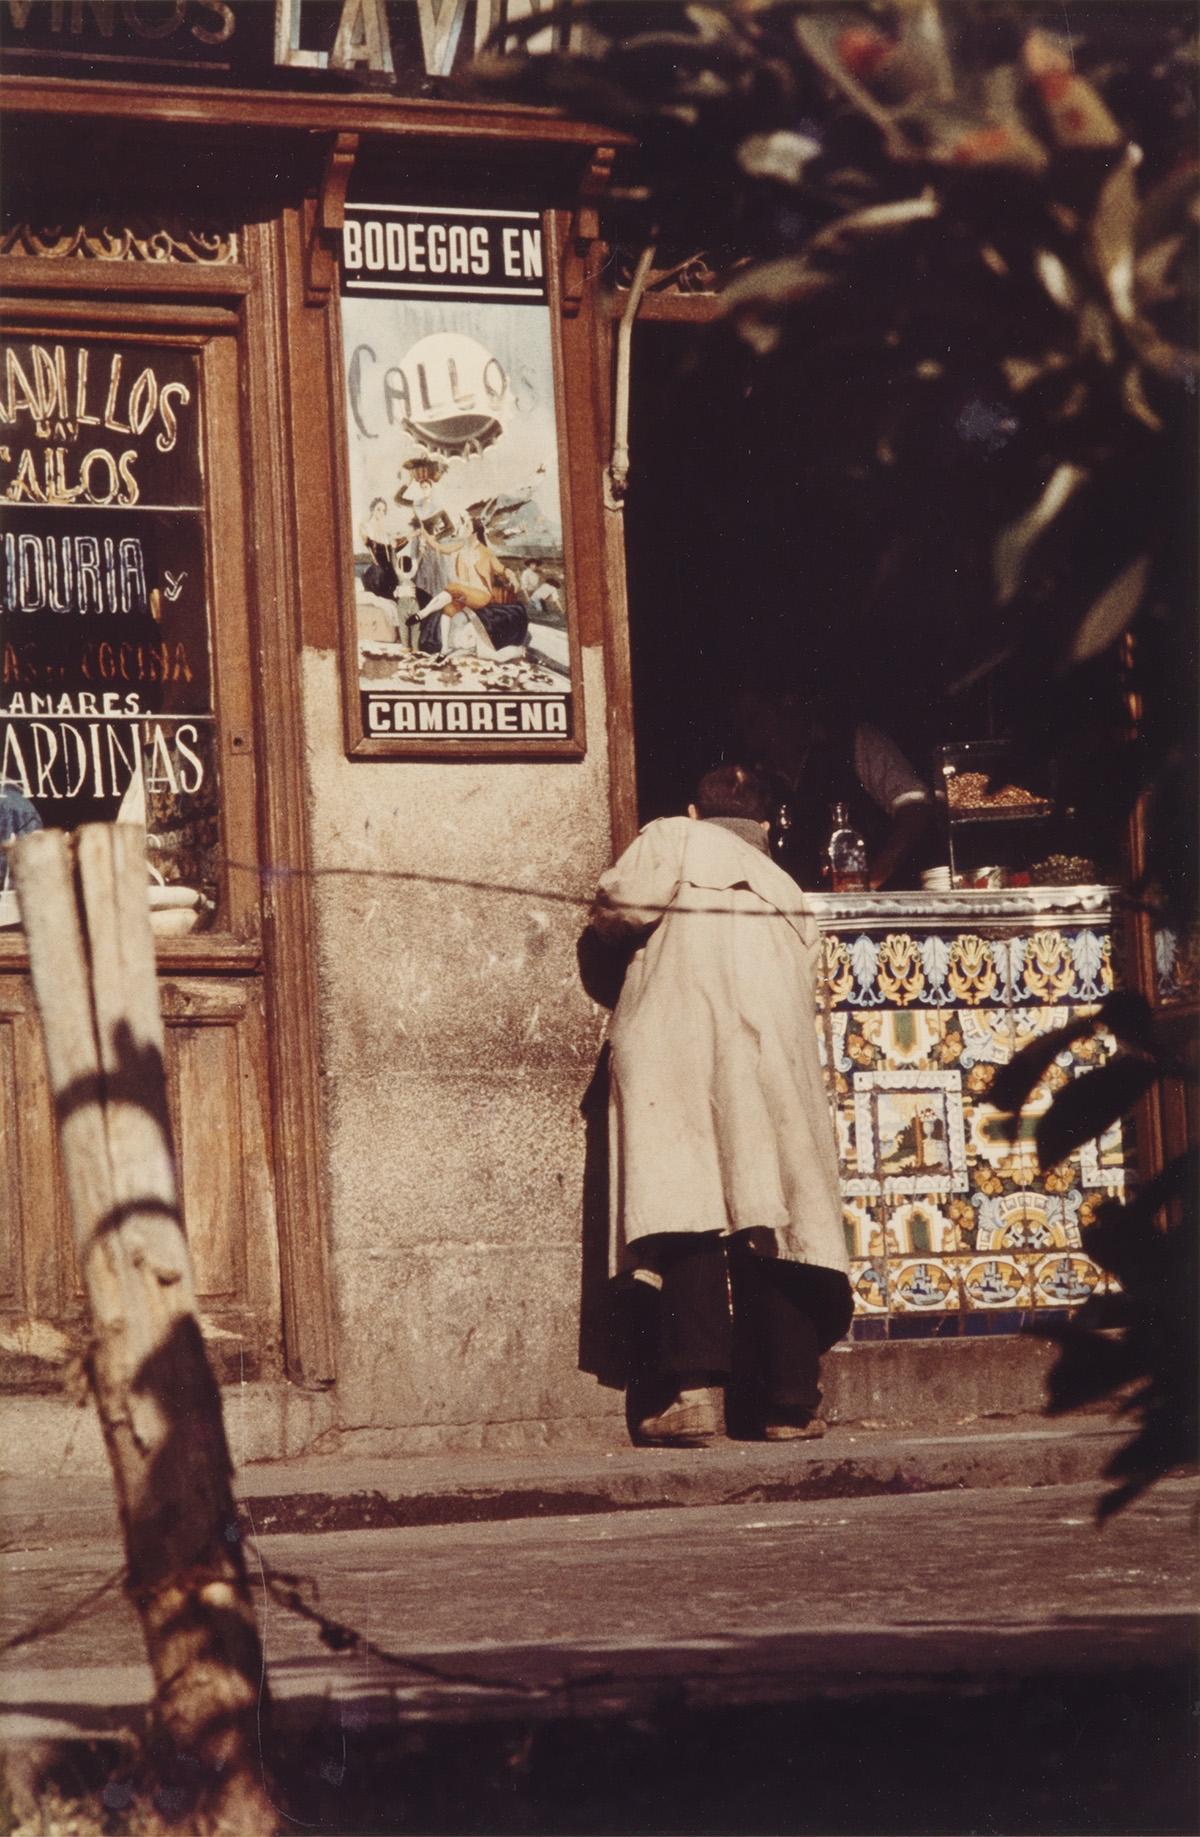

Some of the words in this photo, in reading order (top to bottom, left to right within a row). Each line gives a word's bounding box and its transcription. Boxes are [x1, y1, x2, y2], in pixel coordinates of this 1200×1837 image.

[343, 220, 490, 275] BODEGAS
[502, 228, 543, 278] EN
[0, 344, 190, 452] ADILLOS
[0, 532, 147, 614] IDURIA
[0, 692, 152, 715] AMARES.
[368, 701, 567, 732] CAMARENA
